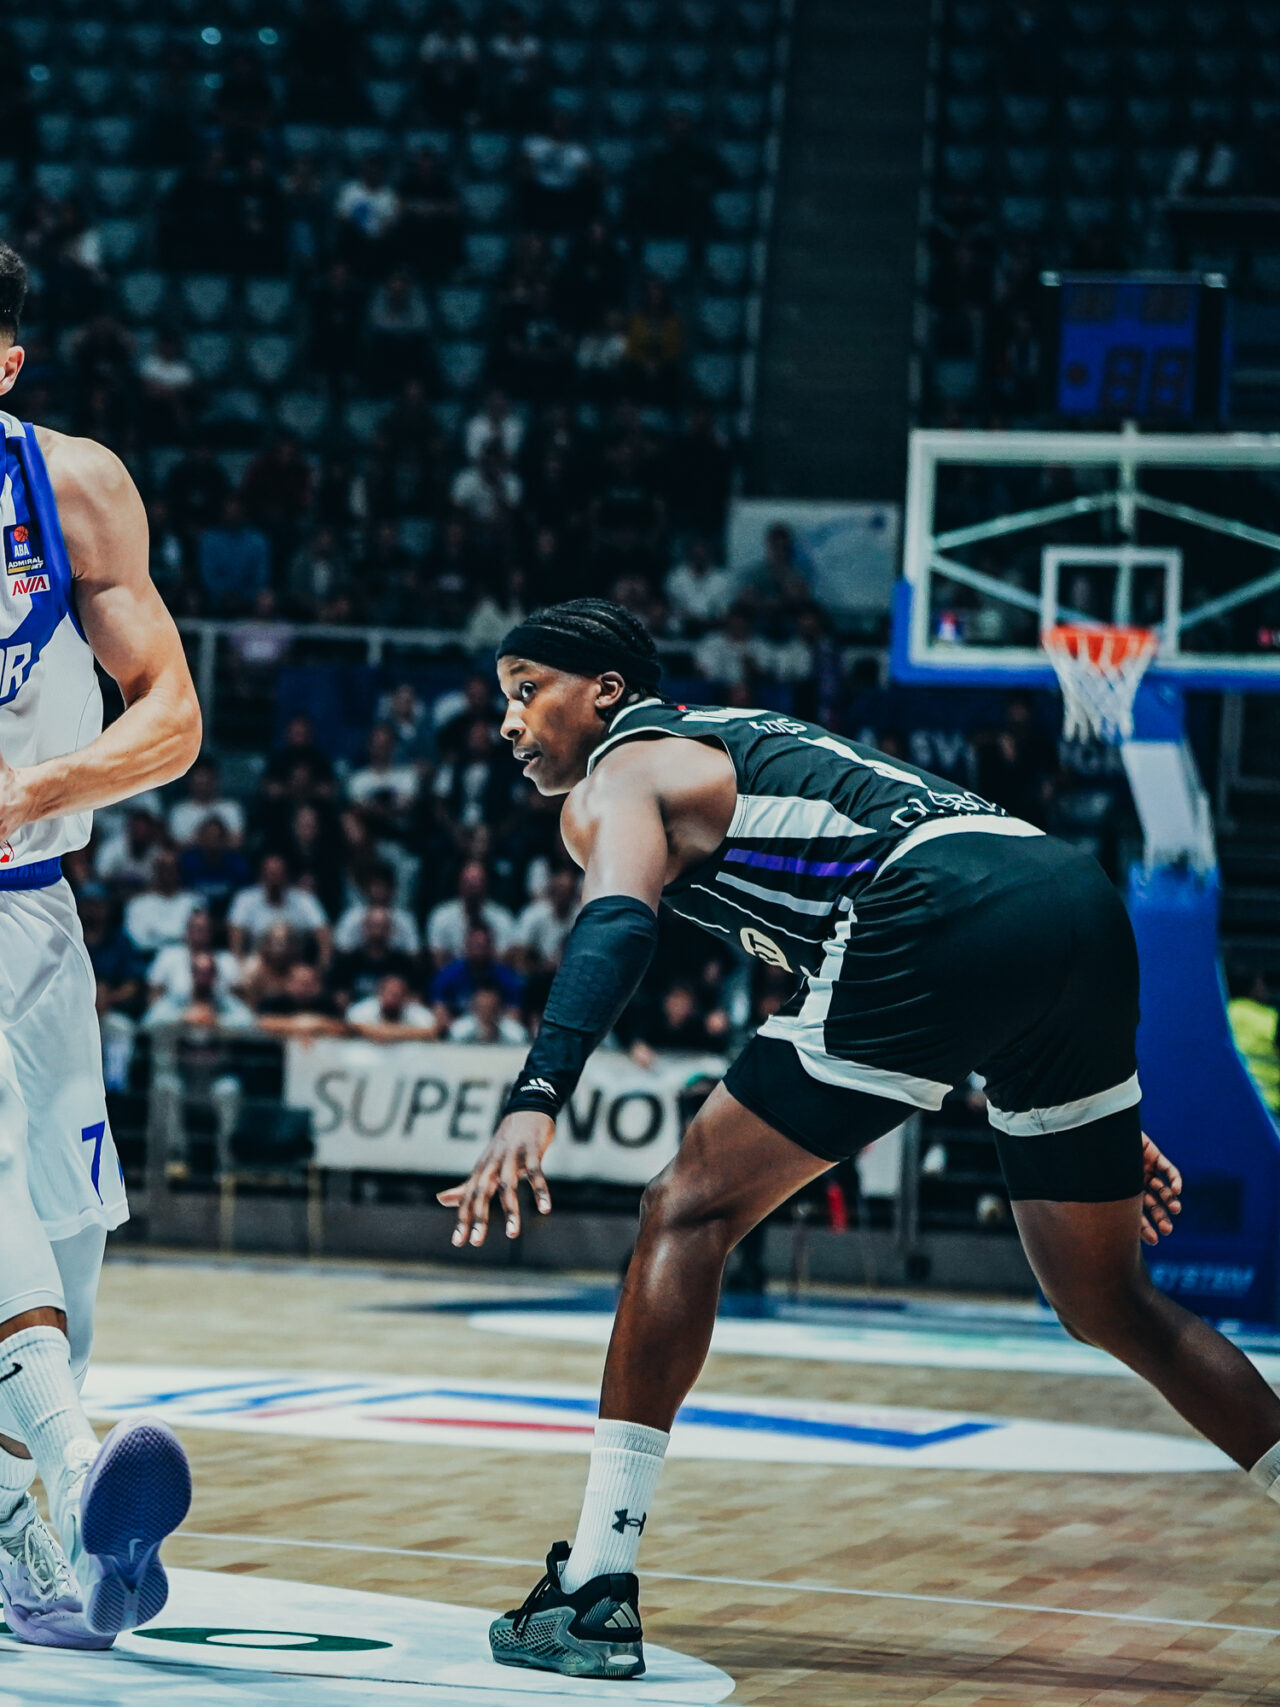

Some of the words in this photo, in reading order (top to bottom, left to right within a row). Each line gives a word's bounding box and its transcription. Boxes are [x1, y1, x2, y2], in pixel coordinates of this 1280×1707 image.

[14, 543, 30, 558] ABA
[7, 556, 43, 569] ADMIRAL
[12, 576, 47, 596] AVIA
[81, 1120, 105, 1206] 7
